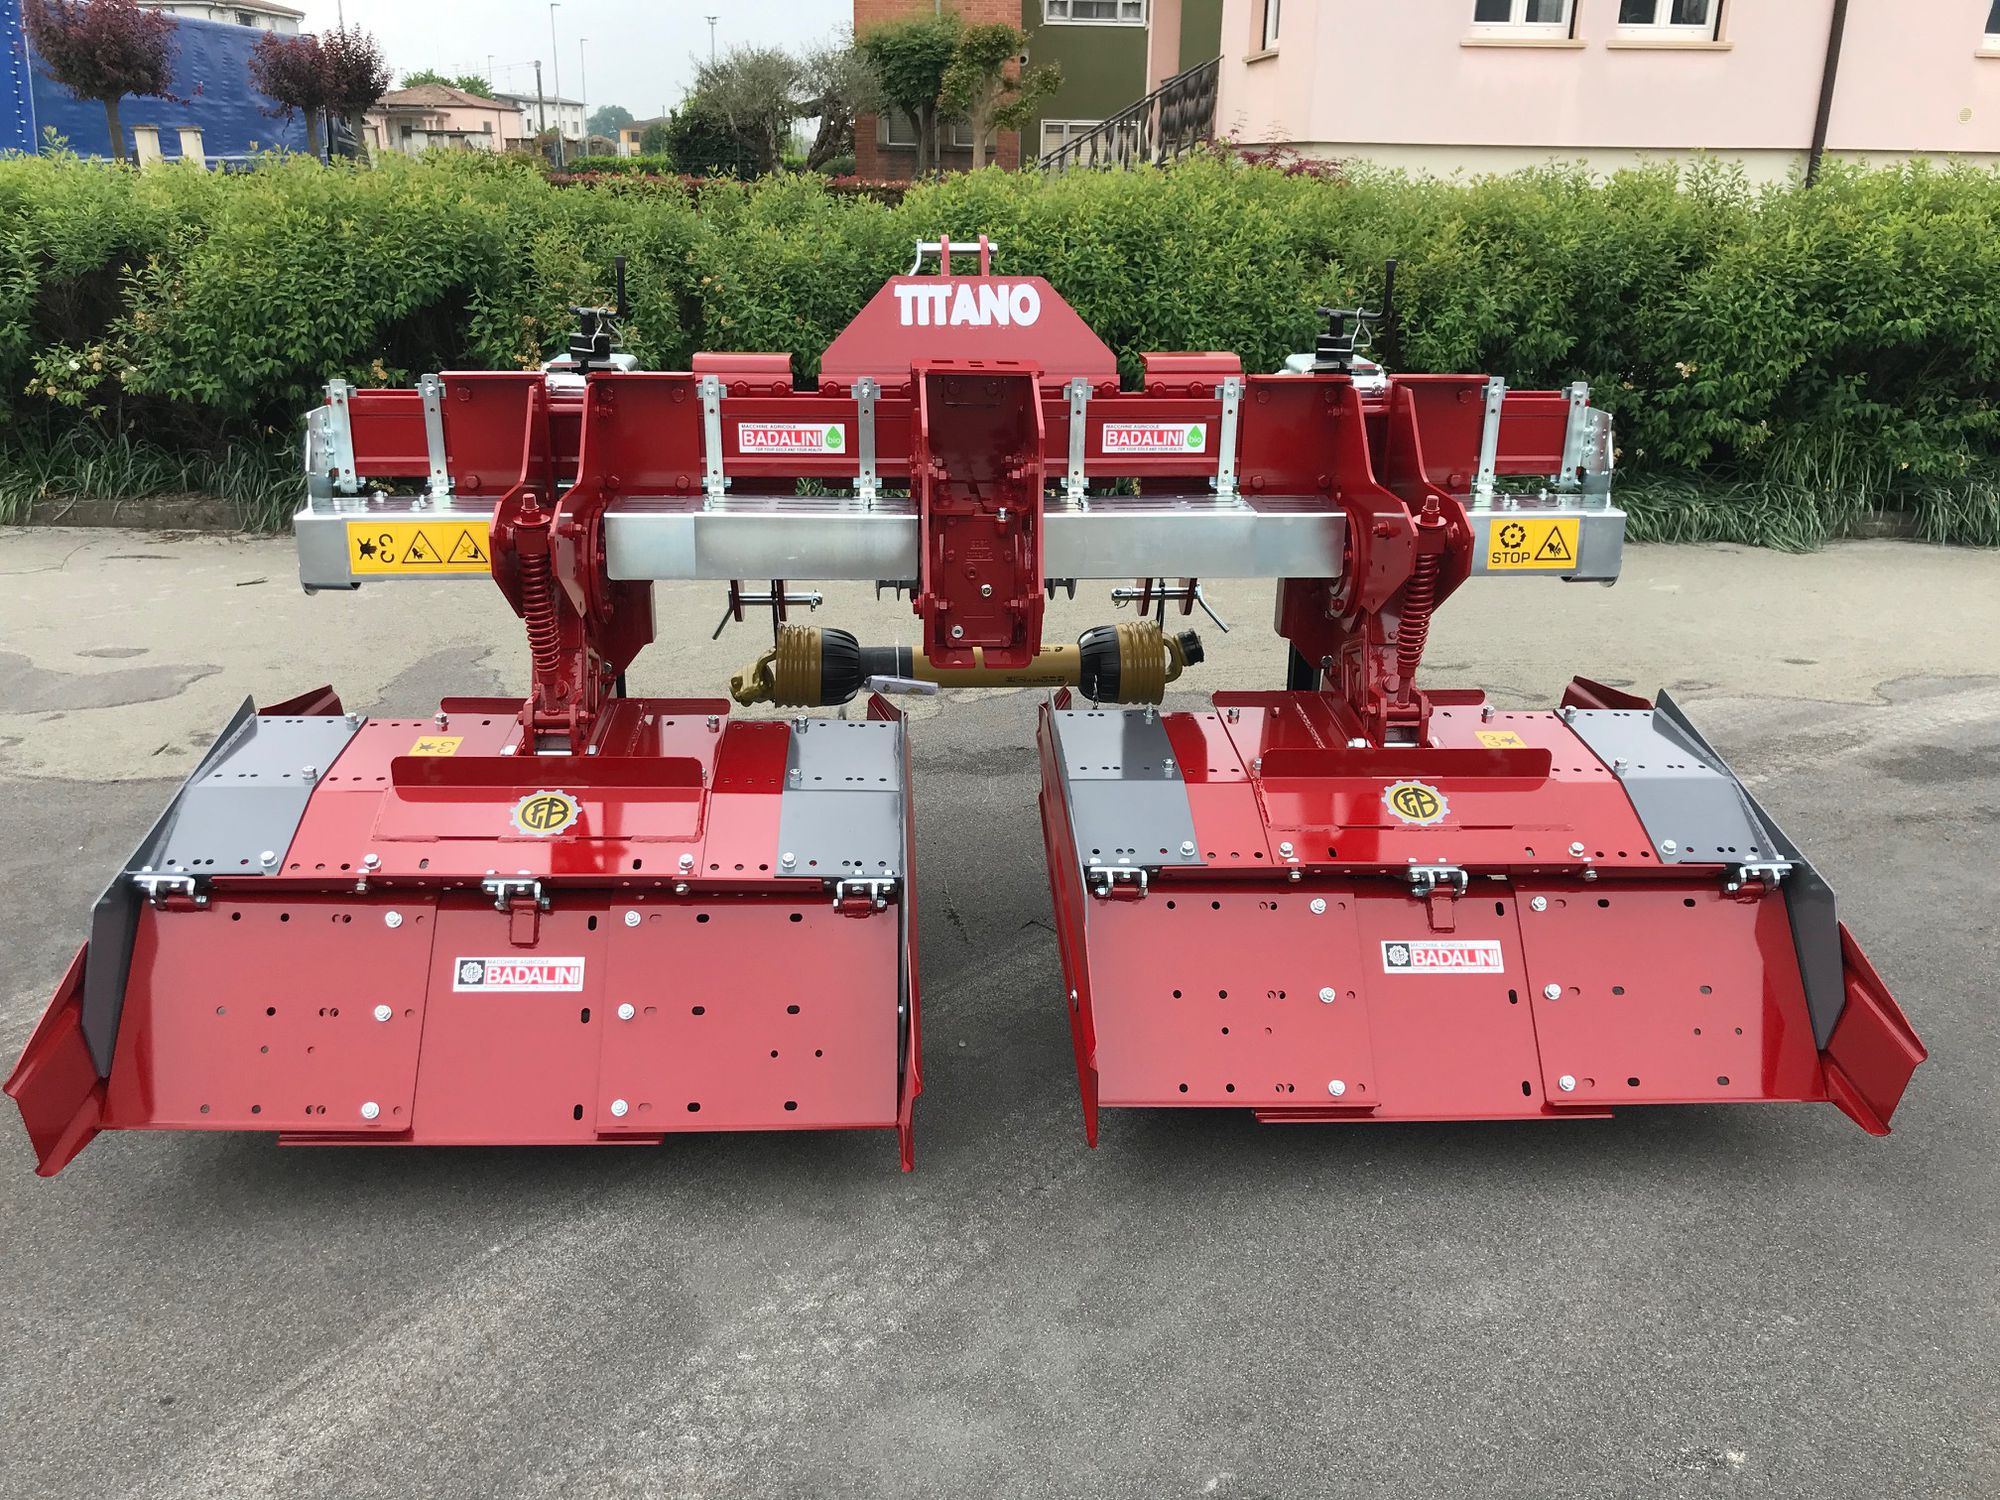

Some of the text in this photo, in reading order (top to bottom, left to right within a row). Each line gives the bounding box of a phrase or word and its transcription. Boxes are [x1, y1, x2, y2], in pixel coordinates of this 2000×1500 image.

[894, 283, 1041, 327] TITANO
[743, 431, 821, 446] BADALINI
[827, 436, 840, 444] bio
[1107, 431, 1183, 446] BADALINI
[1189, 435, 1201, 444] bio
[1491, 551, 1531, 564] STOP
[1412, 949, 1499, 966] BADALINI
[487, 966, 579, 984] BADALINI
